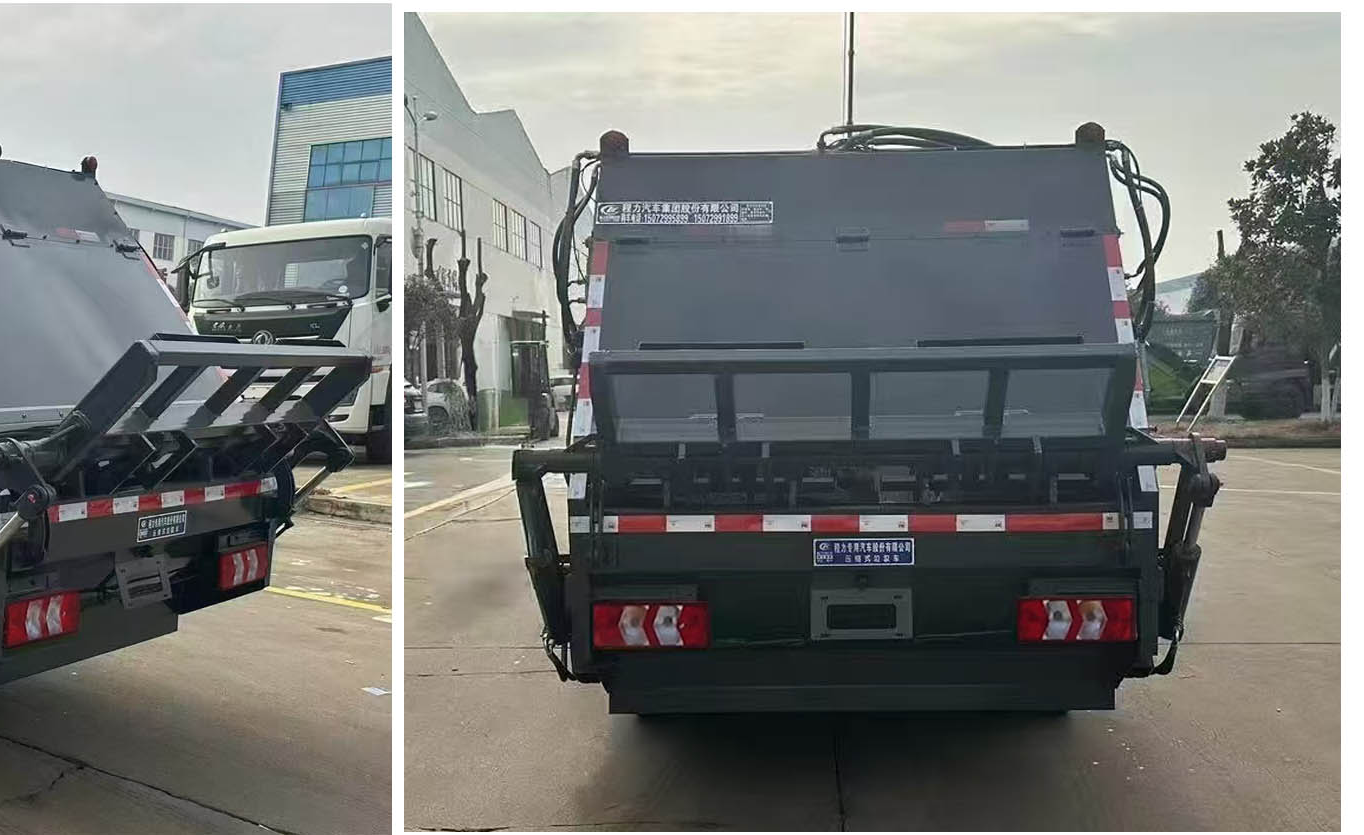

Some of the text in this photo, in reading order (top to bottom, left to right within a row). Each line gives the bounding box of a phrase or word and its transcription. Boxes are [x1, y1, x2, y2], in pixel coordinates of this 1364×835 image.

[834, 542, 911, 554] 程力专用汽车股份有限公司
